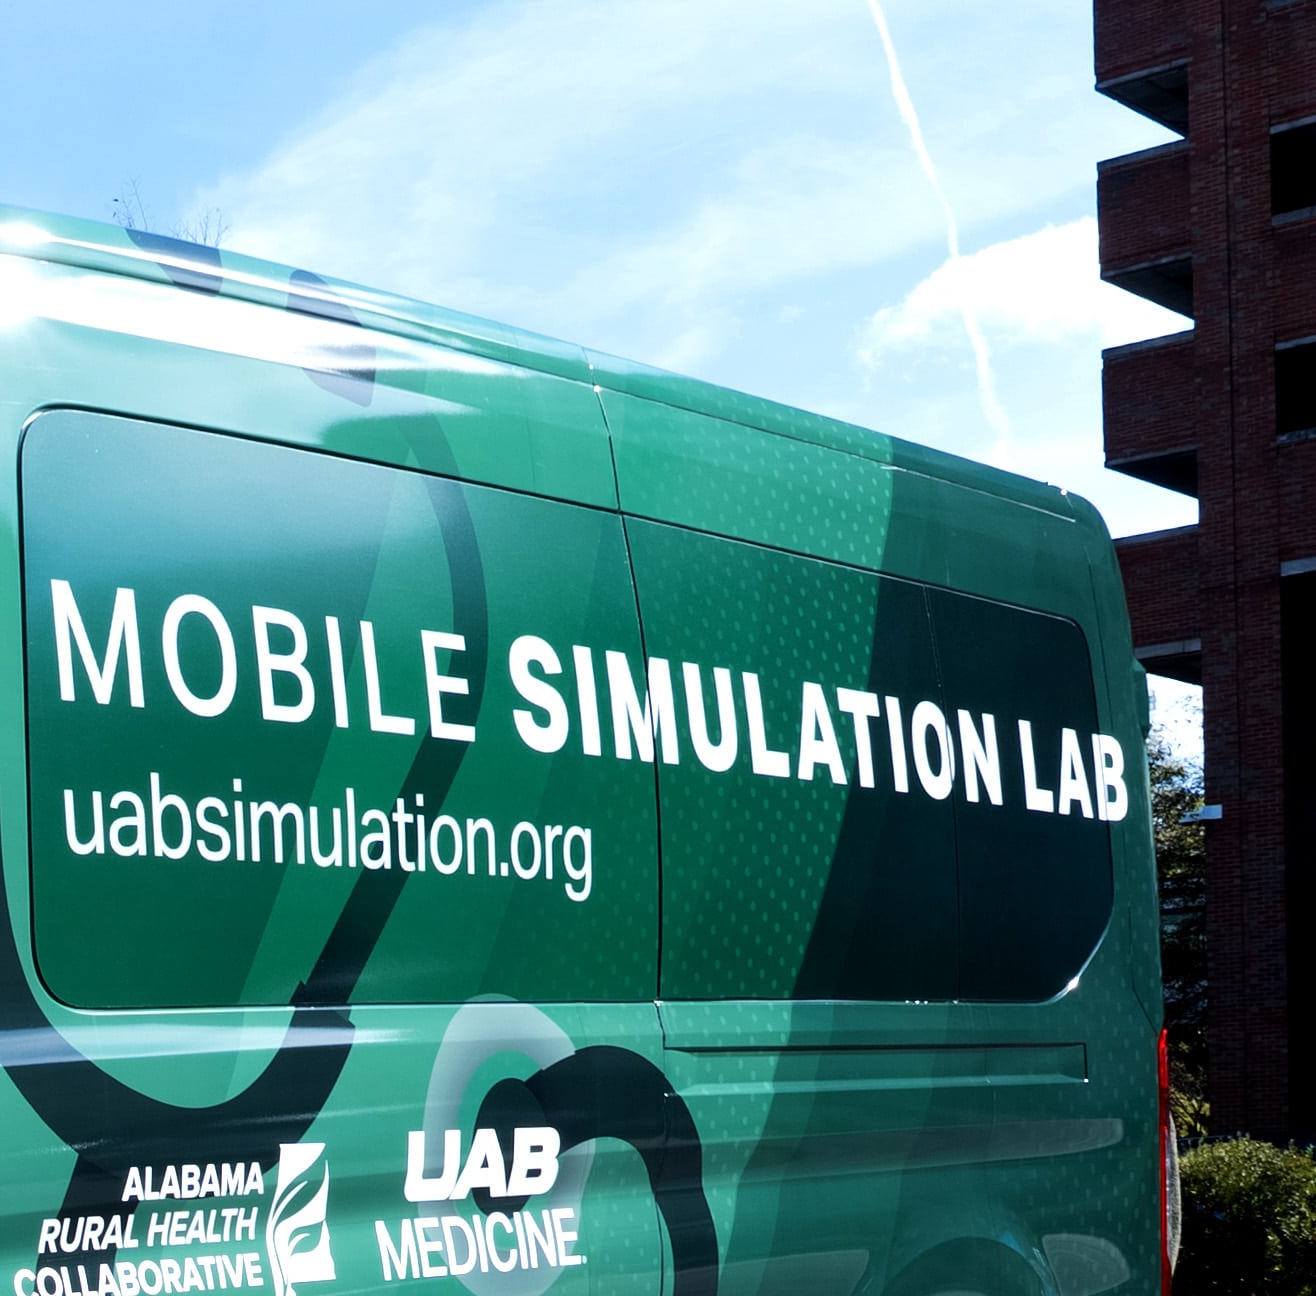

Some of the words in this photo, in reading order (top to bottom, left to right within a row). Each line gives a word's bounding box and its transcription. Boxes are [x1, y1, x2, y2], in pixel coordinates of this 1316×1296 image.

[50, 578, 476, 743] MOBILE
[508, 633, 1004, 807] SIMULATION
[1018, 718, 1129, 823] LAB
[63, 772, 593, 902] uabsimulation.org
[121, 1161, 265, 1202] ALABAMA
[403, 1125, 561, 1203] UAB
[37, 1213, 140, 1255] RURAL
[146, 1206, 260, 1248] HEALTH
